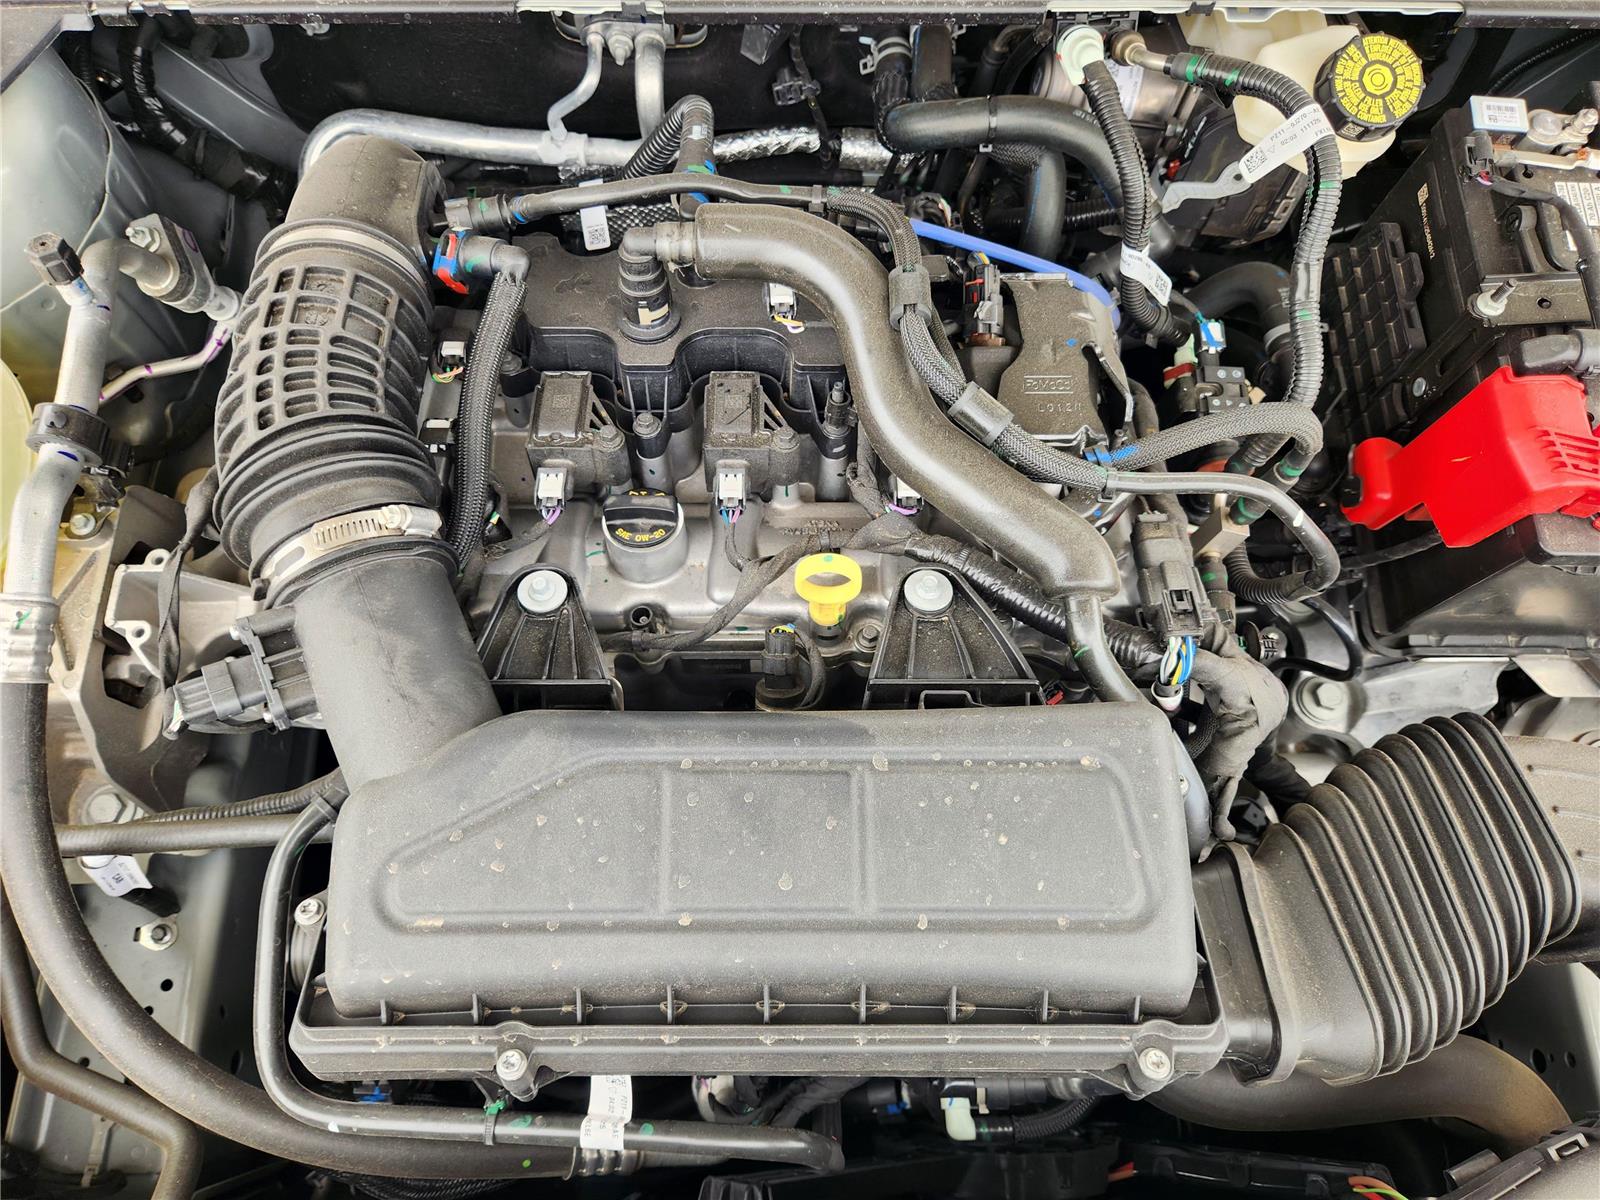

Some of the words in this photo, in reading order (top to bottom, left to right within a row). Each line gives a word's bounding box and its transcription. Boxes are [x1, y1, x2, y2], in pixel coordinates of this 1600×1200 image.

[1362, 35, 1389, 47] ATTENTION
[1335, 57, 1348, 75] FLUID
[1334, 75, 1345, 92] FROM
[1351, 50, 1363, 63] CAP
[1358, 101, 1371, 114] USE
[1351, 82, 1366, 101] CLEAN
[1340, 96, 1360, 115] SEALED
[1357, 110, 1387, 124] CONTAINER
[615, 527, 633, 540] SAE
[634, 528, 666, 542] 0W-20
